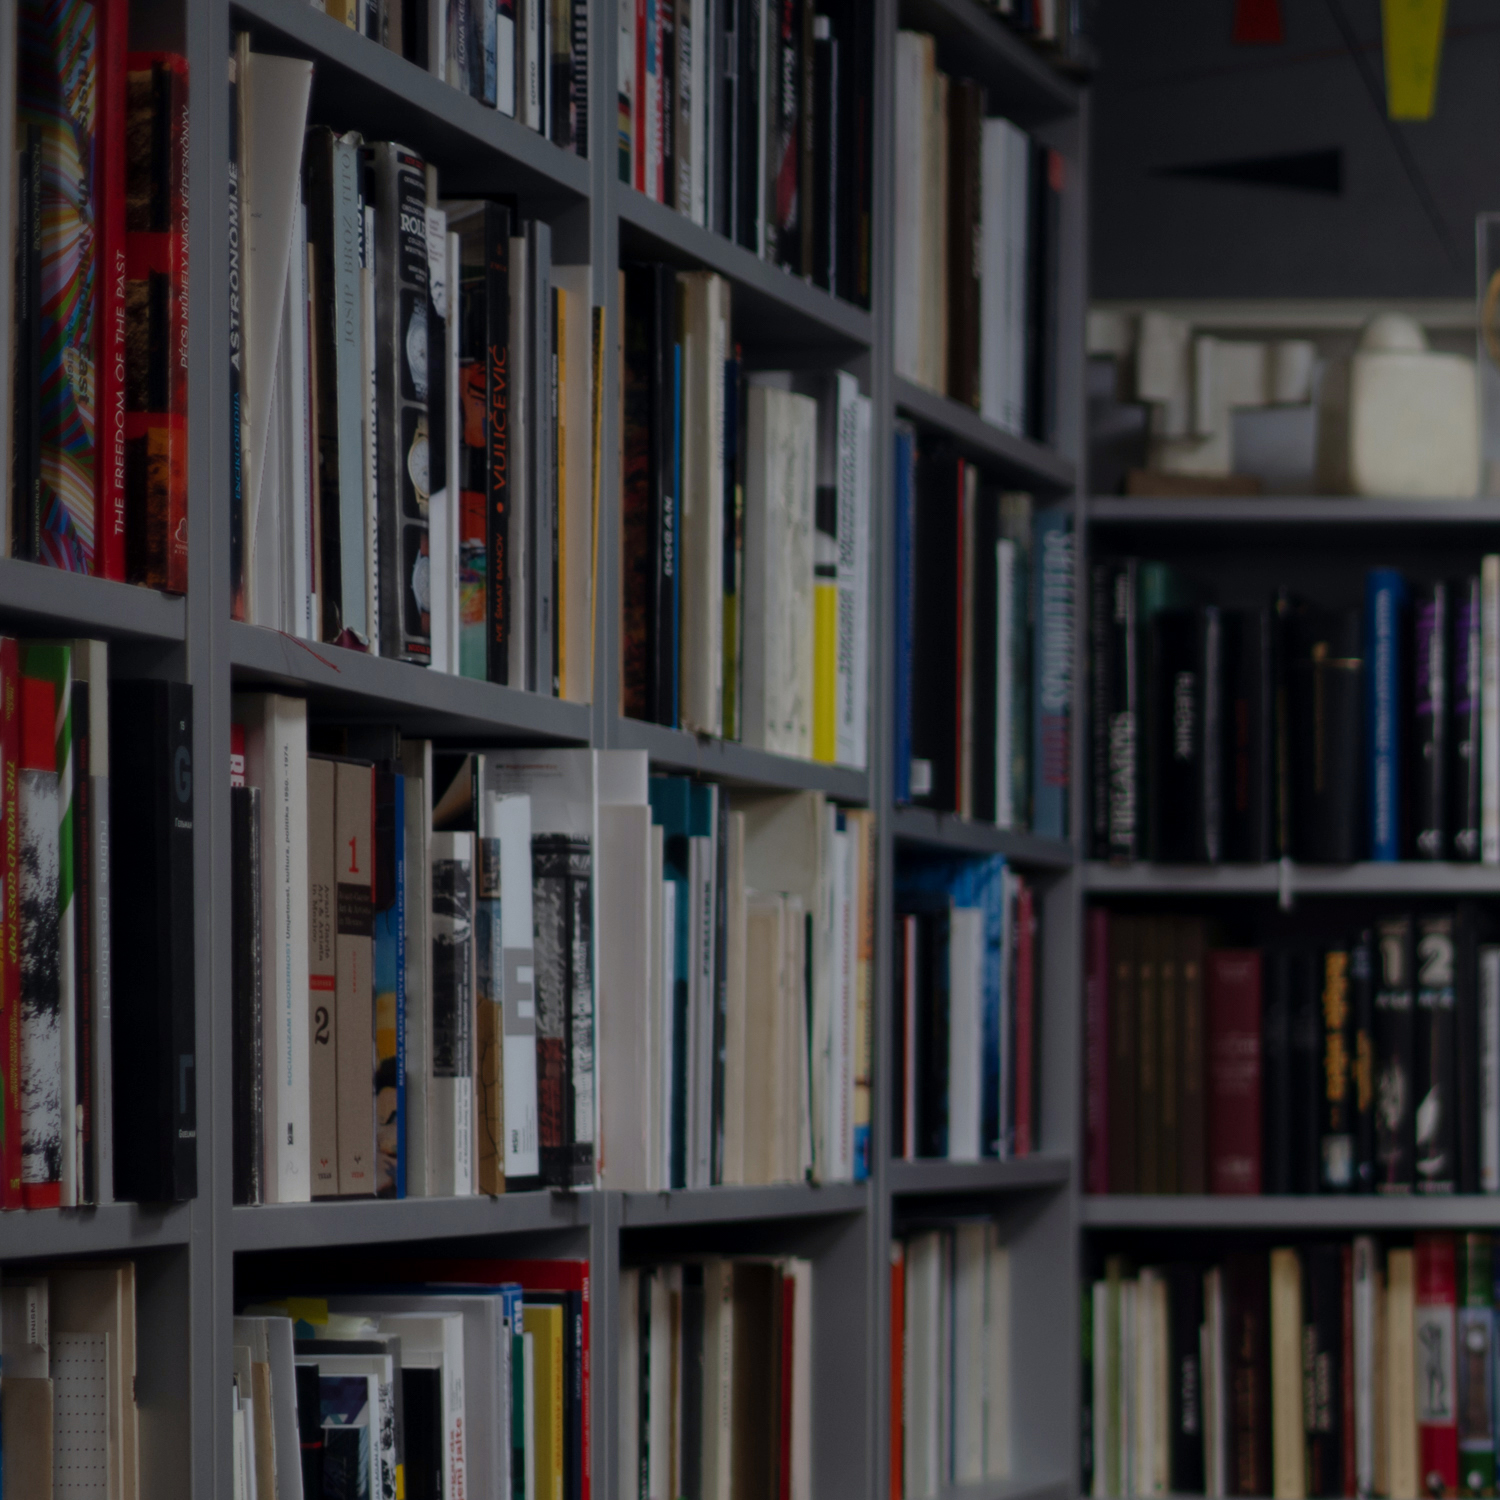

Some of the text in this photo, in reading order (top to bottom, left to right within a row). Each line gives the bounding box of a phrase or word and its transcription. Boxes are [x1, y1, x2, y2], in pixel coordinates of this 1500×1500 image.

[32, 145, 41, 250] BOSCH+BOSCH
[77, 33, 92, 403] Artists the Middle East
[178, 105, 191, 367] PÉCSI MŰHELY NAGY KÉPESKÖNYV
[341, 154, 355, 347] JOSIP BROZ TITO
[114, 248, 126, 535] THE FREEDOM OF THE PAST
[229, 163, 241, 499] ENCIKLOPEDIJA ASTRONOMIJE
[489, 344, 506, 489] VULIČEVIĆ
[492, 533, 503, 641] IVE ŠIMAT BANOV
[174, 745, 191, 802] G
[284, 806, 293, 842] politika
[6, 762, 17, 963] THE WORLD GOES POP
[98, 821, 111, 1020] rubne posebnosti
[349, 837, 360, 872] 1
[285, 943, 294, 1012] MODERNOST
[314, 1006, 330, 1045] 2
